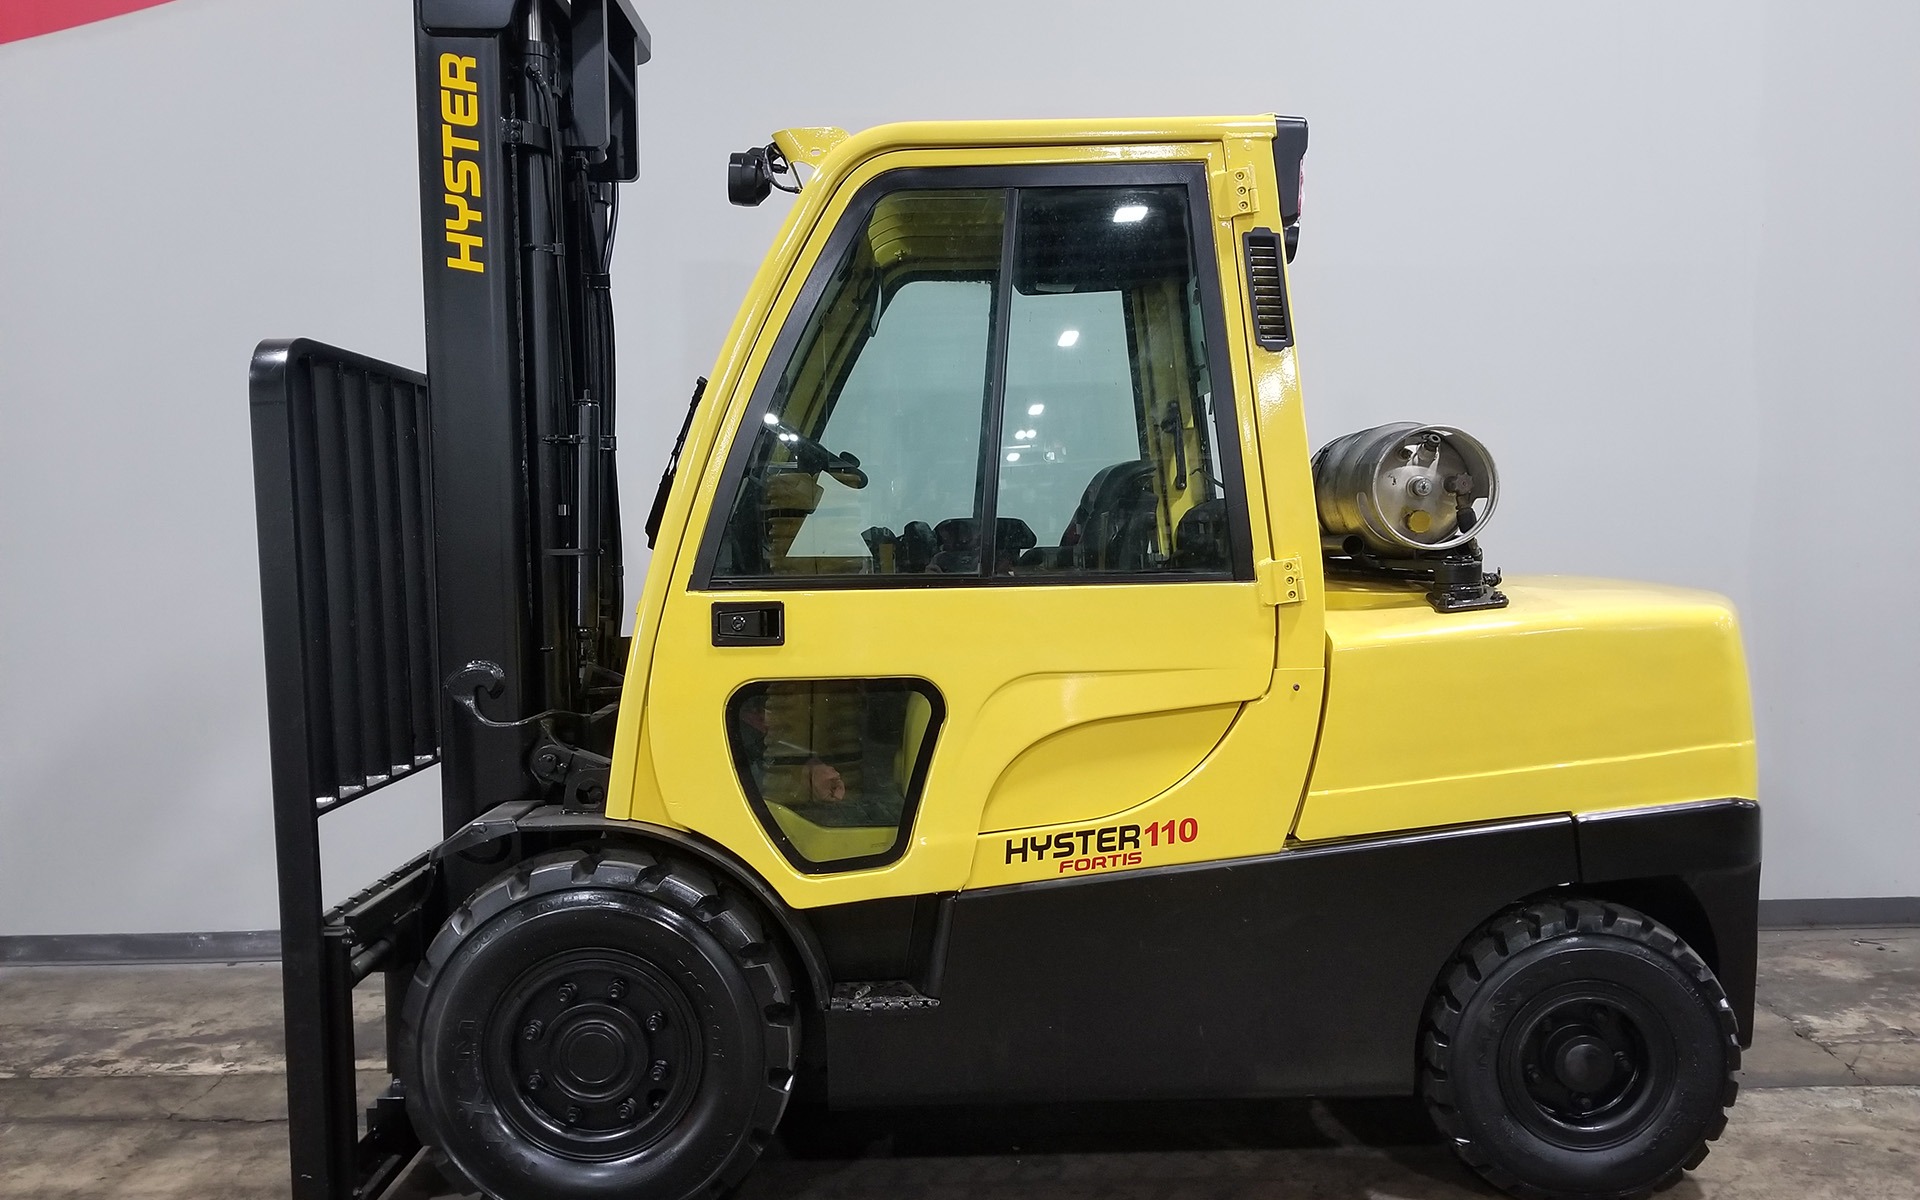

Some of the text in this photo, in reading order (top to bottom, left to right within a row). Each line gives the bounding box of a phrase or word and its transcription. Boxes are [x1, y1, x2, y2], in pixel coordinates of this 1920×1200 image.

[439, 52, 484, 273] HYSTER
[1005, 818, 1198, 864] HYSTER 110
[1059, 852, 1142, 873] FORTIS
